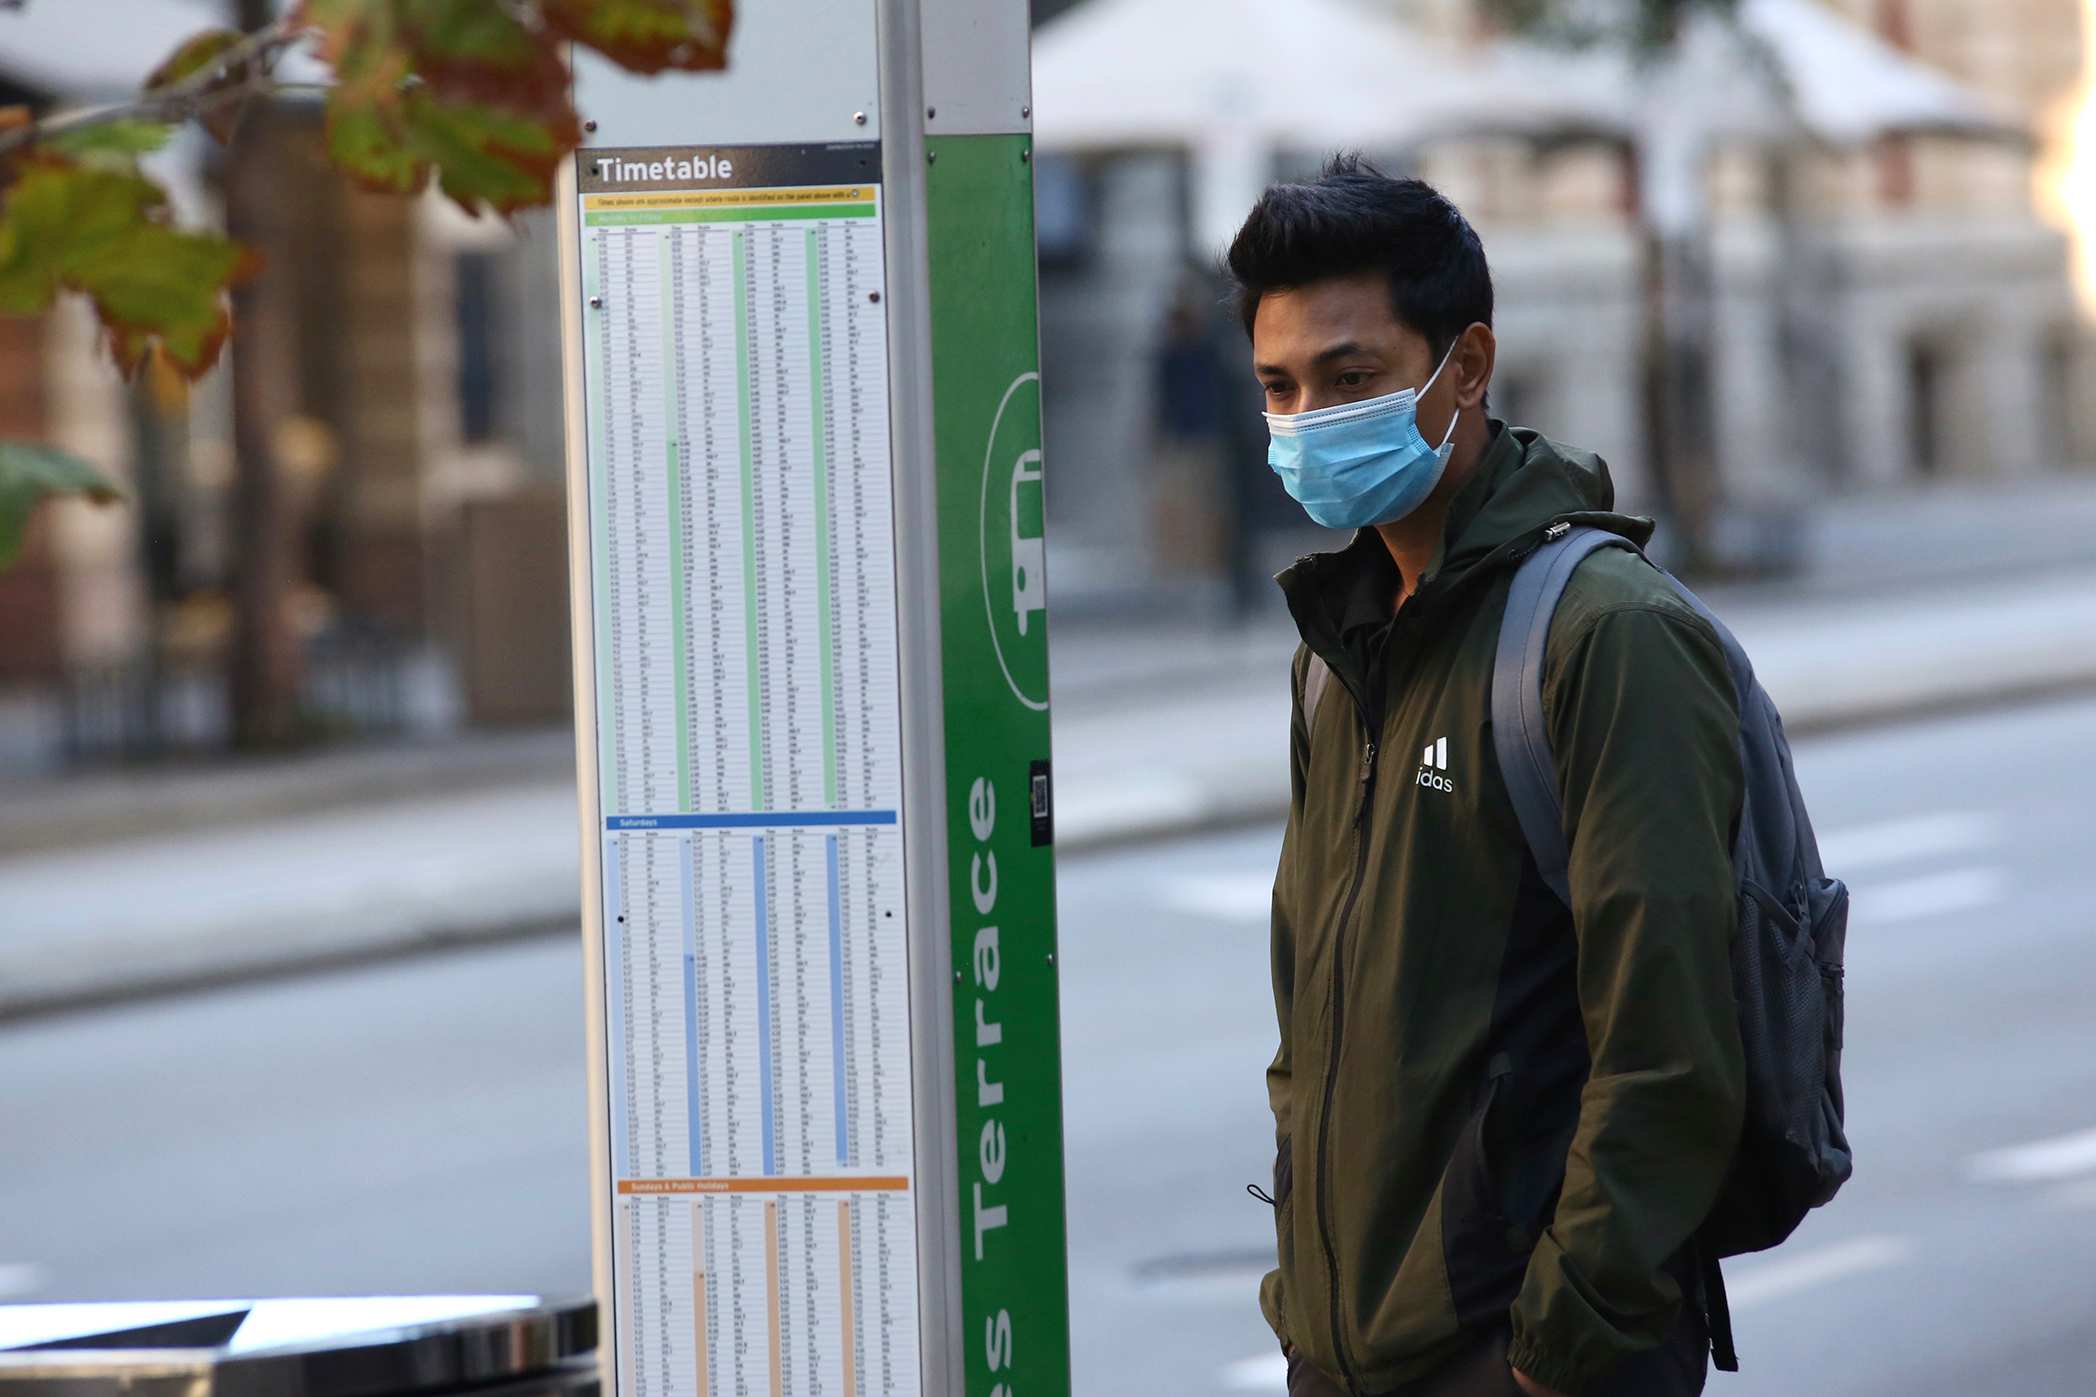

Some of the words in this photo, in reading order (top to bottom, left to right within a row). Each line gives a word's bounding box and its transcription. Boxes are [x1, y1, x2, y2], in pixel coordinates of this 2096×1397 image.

[597, 155, 732, 181] Timetable
[1415, 766, 1453, 793] idas
[969, 776, 1008, 1260] Terrace
